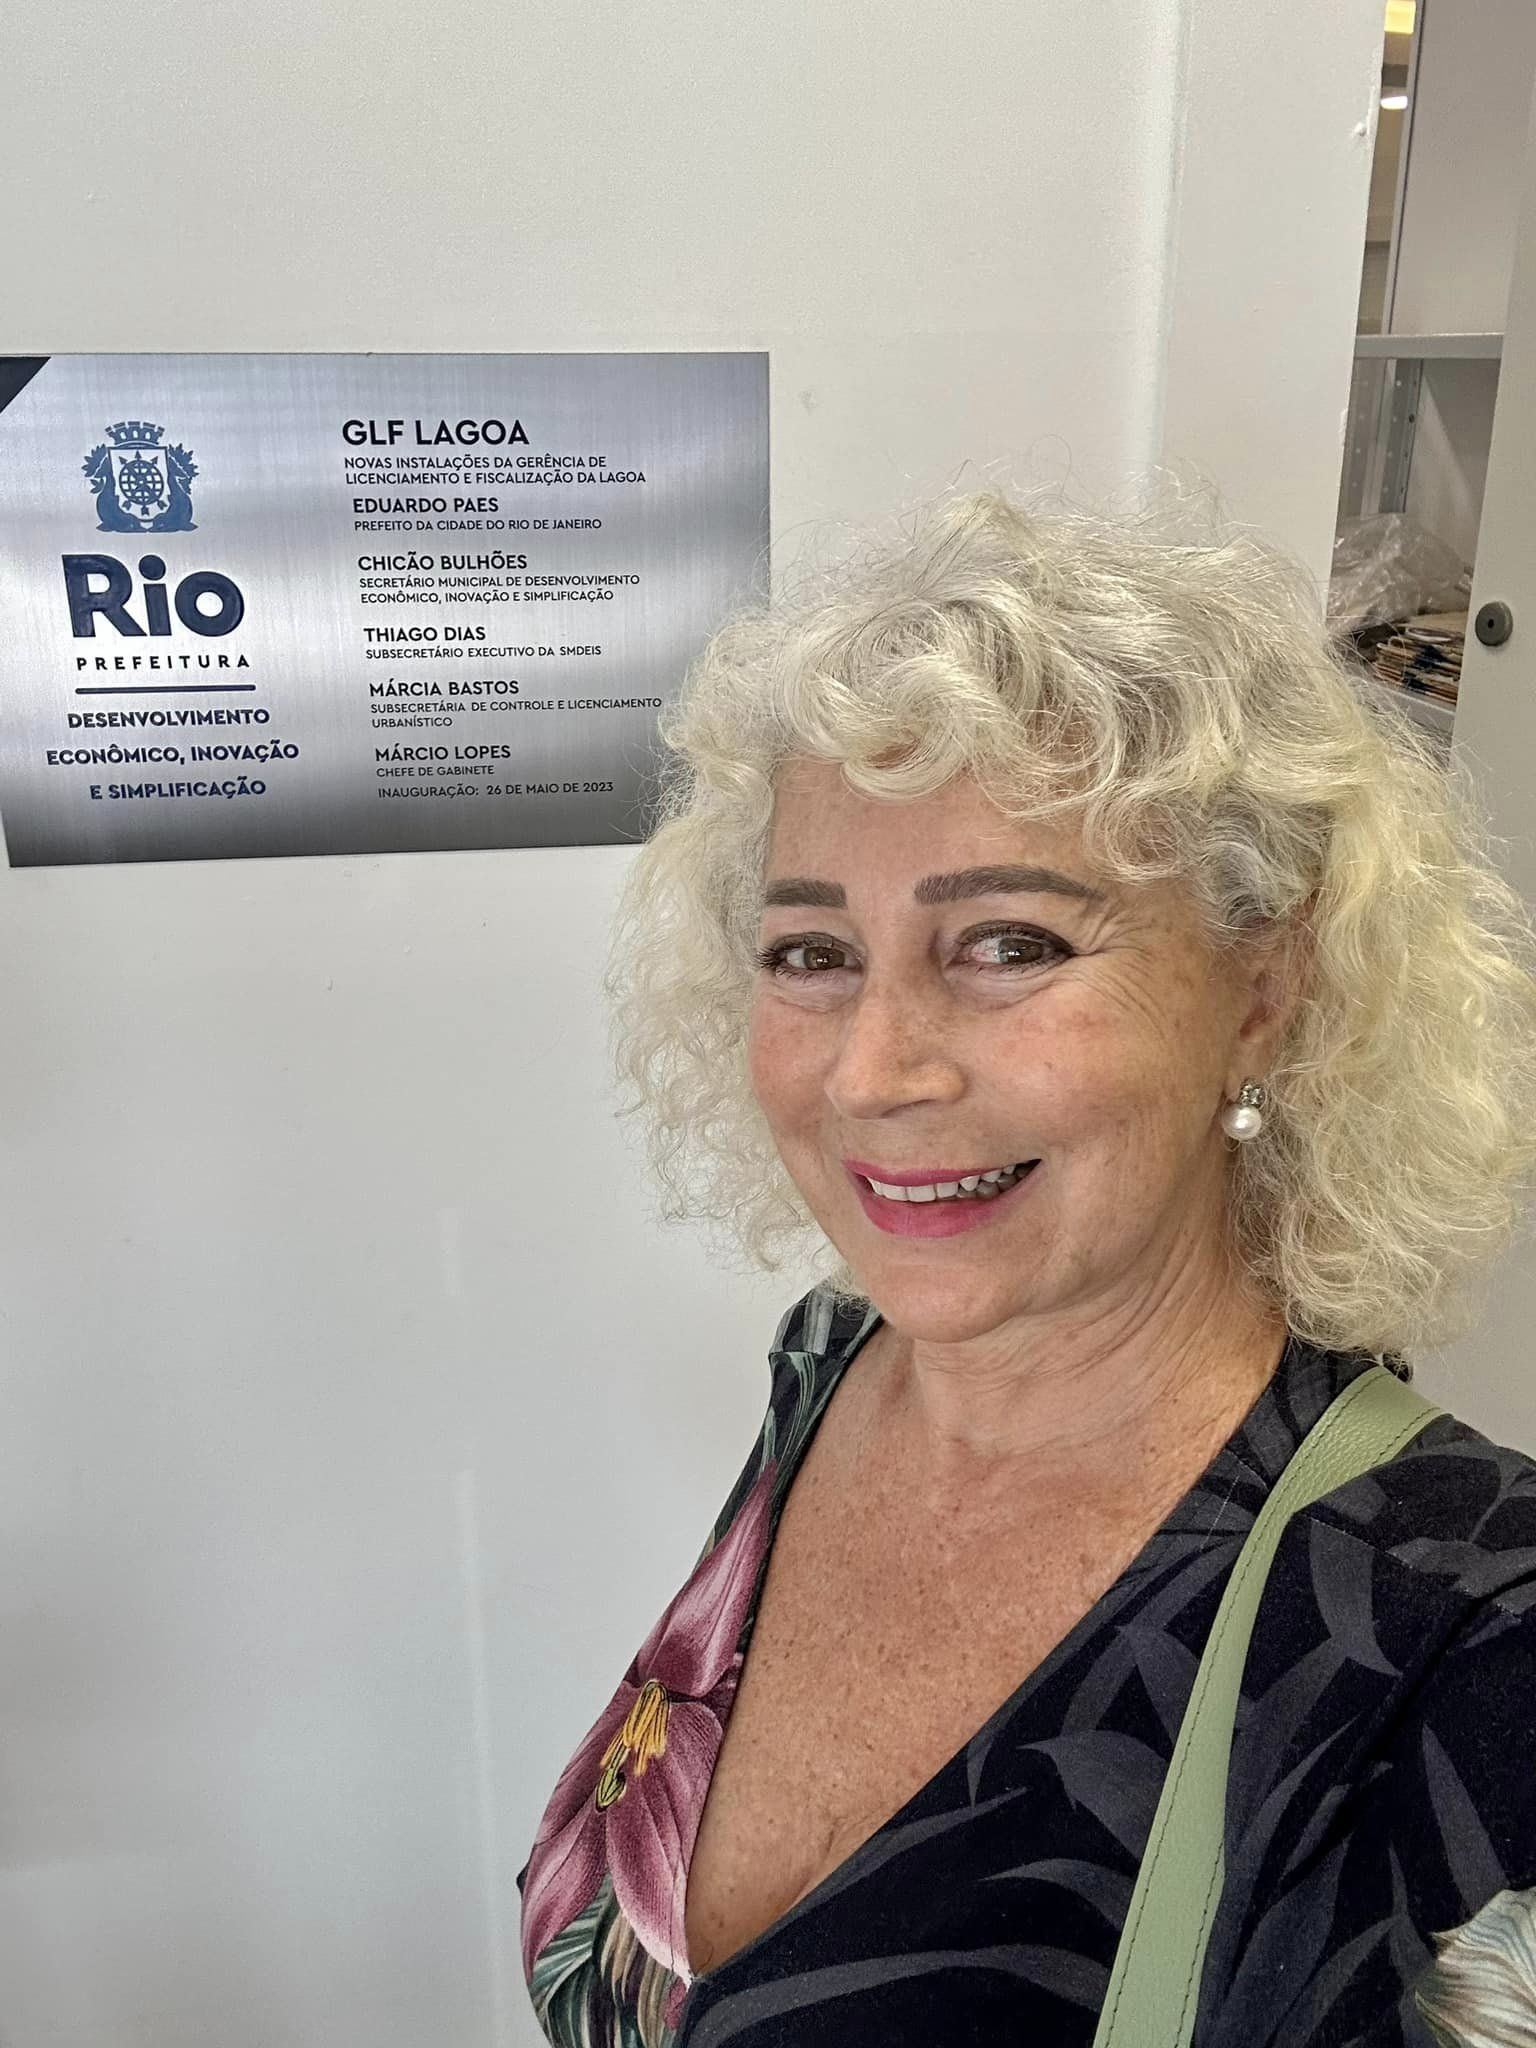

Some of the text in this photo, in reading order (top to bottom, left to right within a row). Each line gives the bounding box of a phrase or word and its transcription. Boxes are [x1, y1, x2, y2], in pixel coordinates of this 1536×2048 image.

[343, 420, 529, 445] GLF LAGOA
[345, 453, 606, 471] NOVAS INSTALAÇÕES DA GERÊNCIA DE
[346, 472, 645, 486] LICENCIAMENTO E FISCALIZAÇÃO DA LAGOA
[353, 498, 498, 513] EDUARDO PAES
[355, 519, 601, 531] PREFEITO DA CIDADE DO RIO DE JANEIRO
[358, 551, 527, 570] CHICÃO BULHÕES
[360, 575, 639, 588] SECRETÁRIO MUNICIPAL DE DESENVOLVIMENTO
[62, 554, 244, 637] Rio
[361, 588, 613, 604] ECONÔMICO, INOVAÇÃO E SIMPLIFICAÇÃO
[364, 627, 485, 642] THIAGO DIAS
[366, 646, 601, 659] SUBSECRETÁRIO EXECUTIVO DA SMDEIS
[77, 655, 249, 670] PREFEITURA
[370, 678, 519, 696] MÁRCIA BASTOS
[371, 698, 662, 713] SUBSECRETÁRIA DE CONTROLE E LICENCIAMENTO
[68, 709, 269, 728] DESENVOLVIMENTO
[372, 715, 452, 728] URBANÍSTICO
[47, 740, 298, 765] ECONÔMICO, INOVAÇÃO
[376, 743, 510, 761] MÁRCIO LOPES
[377, 765, 494, 777] CHEFE DE GABINETE
[90, 776, 266, 799] E SIMPLIFICAÇÃO
[379, 782, 613, 799] INAUGURAÇÃO: 26 DE MAIO DE 2023
